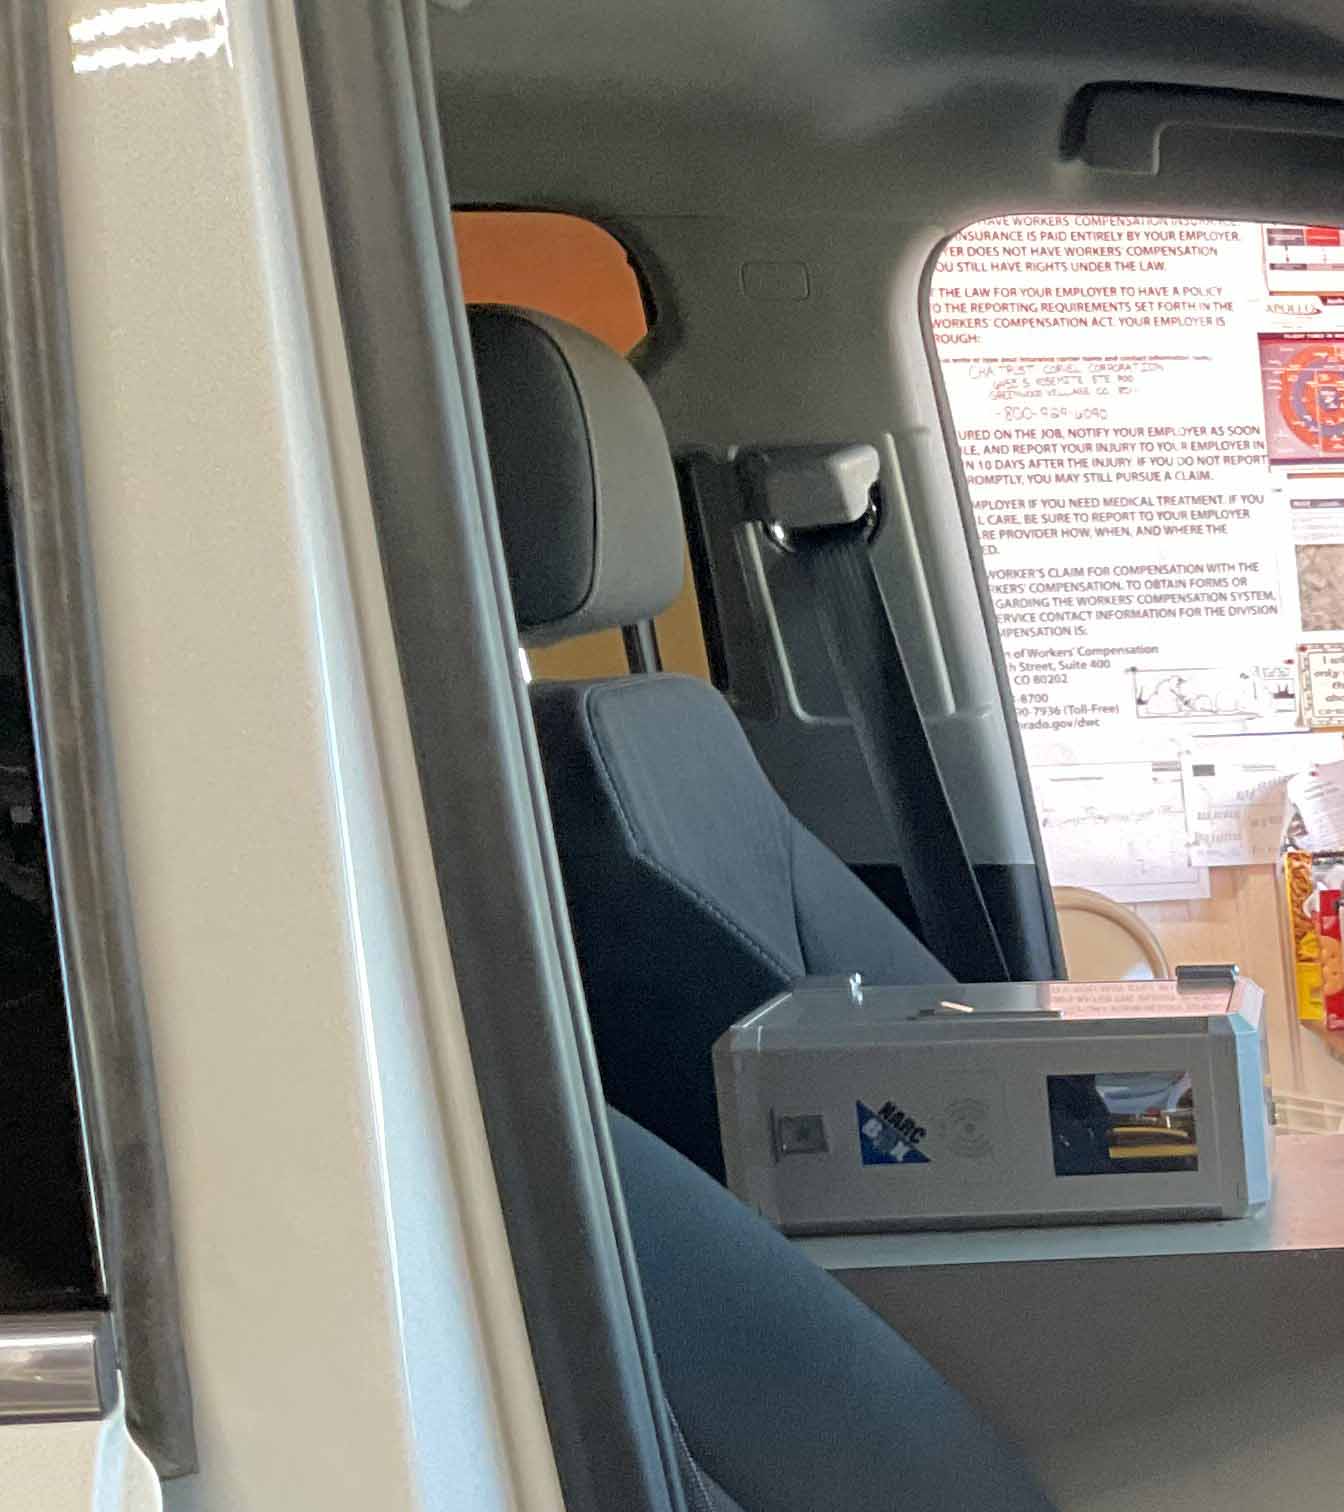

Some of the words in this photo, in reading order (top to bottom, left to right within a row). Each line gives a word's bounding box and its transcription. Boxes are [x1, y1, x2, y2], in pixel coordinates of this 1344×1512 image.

[1027, 231, 1037, 242] IS
[1040, 231, 1067, 242] PAID
[1070, 231, 1123, 242] ENTIRELY
[1126, 231, 1140, 242] BY
[1144, 231, 1176, 242] YOUR
[967, 246, 999, 257] DOES
[1002, 246, 1026, 257] NOT
[1031, 246, 1061, 257] HAVE
[1126, 246, 1217, 257] COMPENSATION
[956, 261, 986, 272] STILL
[991, 262, 1022, 273] HAVE
[1025, 262, 1067, 273] RIGHTS
[1071, 262, 1112, 273] UNDER
[1114, 261, 1136, 272] THE
[938, 288, 961, 299] THE
[965, 288, 990, 299] LAW
[993, 287, 1017, 298] FOR
[1021, 287, 1053, 298] YOUR
[1054, 287, 1117, 298] EMPLOYER
[1120, 286, 1135, 297] TO
[1138, 286, 1168, 297] HAVE
[1183, 286, 1222, 297] POLICY
[943, 303, 967, 314] THE
[970, 302, 1038, 313] REPORTING
[1040, 302, 1131, 313] REQUIREMENTS
[1135, 302, 1154, 313] SET
[1157, 301, 1196, 312] FORTH
[1214, 301, 1232, 312] THE
[993, 317, 1089, 328] COMPENSATION
[1119, 316, 1151, 327] YOUR
[1153, 316, 1212, 327] EMPLOYER
[1216, 317, 1225, 328] IS
[994, 429, 1012, 440] ON
[1015, 429, 1037, 440] THE
[1067, 428, 1109, 439] NOTIFY
[1113, 427, 1144, 438] YOUR
[1211, 426, 1224, 437] AS
[1227, 425, 1260, 436] SOON
[984, 445, 1010, 456] AND
[1013, 444, 1057, 455] REPORT
[1060, 443, 1093, 454] YOUR
[1096, 442, 1136, 453] INJURY
[1140, 442, 1154, 453] TO
[1190, 440, 1250, 451] EMPLOYER
[1253, 439, 1266, 450] IN
[978, 460, 993, 471] 10
[995, 459, 1025, 470] DAYS
[1028, 458, 1064, 469] AFTER
[1067, 458, 1088, 469] THE
[1137, 456, 1146, 467] IF
[1150, 456, 1173, 467] YOU
[1197, 455, 1220, 466] NOT
[1223, 454, 1268, 465] REPORT
[1027, 474, 1052, 485] YOU
[1055, 473, 1079, 484] MAY
[1083, 472, 1112, 483] STILL
[1116, 471, 1161, 482] PURSUE
[1028, 499, 1037, 510] IF
[1040, 498, 1065, 509] YOU
[1068, 498, 1100, 509] NEED
[1103, 497, 1154, 508] MEDICAL
[1229, 494, 1236, 505] IF
[1240, 494, 1264, 505] YOU
[1024, 514, 1038, 525] BE
[1041, 513, 1071, 524] SURE
[1073, 513, 1089, 524] TO
[1091, 512, 1135, 523] REPORT
[1139, 510, 1154, 522] TO
[1156, 510, 1188, 521] YOUR
[1190, 509, 1250, 520] EMPLOYER
[999, 528, 1058, 539] PROVIDER
[1136, 525, 1162, 536] AND
[1163, 524, 1203, 535] WHERE
[1206, 524, 1227, 535] THE
[1048, 568, 1085, 579] CLAIM
[1087, 566, 1110, 577] FOR
[1113, 564, 1204, 576] COMPENSATION
[1206, 563, 1235, 574] WITH
[1238, 562, 1259, 573] THE
[1126, 580, 1141, 591] TO
[1144, 579, 1187, 590] OBTAIN
[1189, 578, 1229, 589] FORMS
[1232, 576, 1247, 587] OR
[1052, 597, 1074, 608] THE
[1137, 592, 1228, 604] COMPENSATION
[1230, 591, 1276, 602] SYSTEM,
[1039, 610, 1092, 622] CONTACT
[1095, 608, 1176, 620] INFORMATION
[1179, 607, 1201, 618] FOR
[1204, 606, 1226, 617] THE
[1228, 605, 1278, 616] DIVISION
[1074, 626, 1087, 637] IS:
[1013, 649, 1025, 660] of
[1076, 646, 1159, 659] Compensation
[1058, 660, 1087, 671] Suite
[1090, 659, 1112, 669] 400
[1014, 675, 1030, 686] CO
[878, 1100, 927, 1145] NARC
